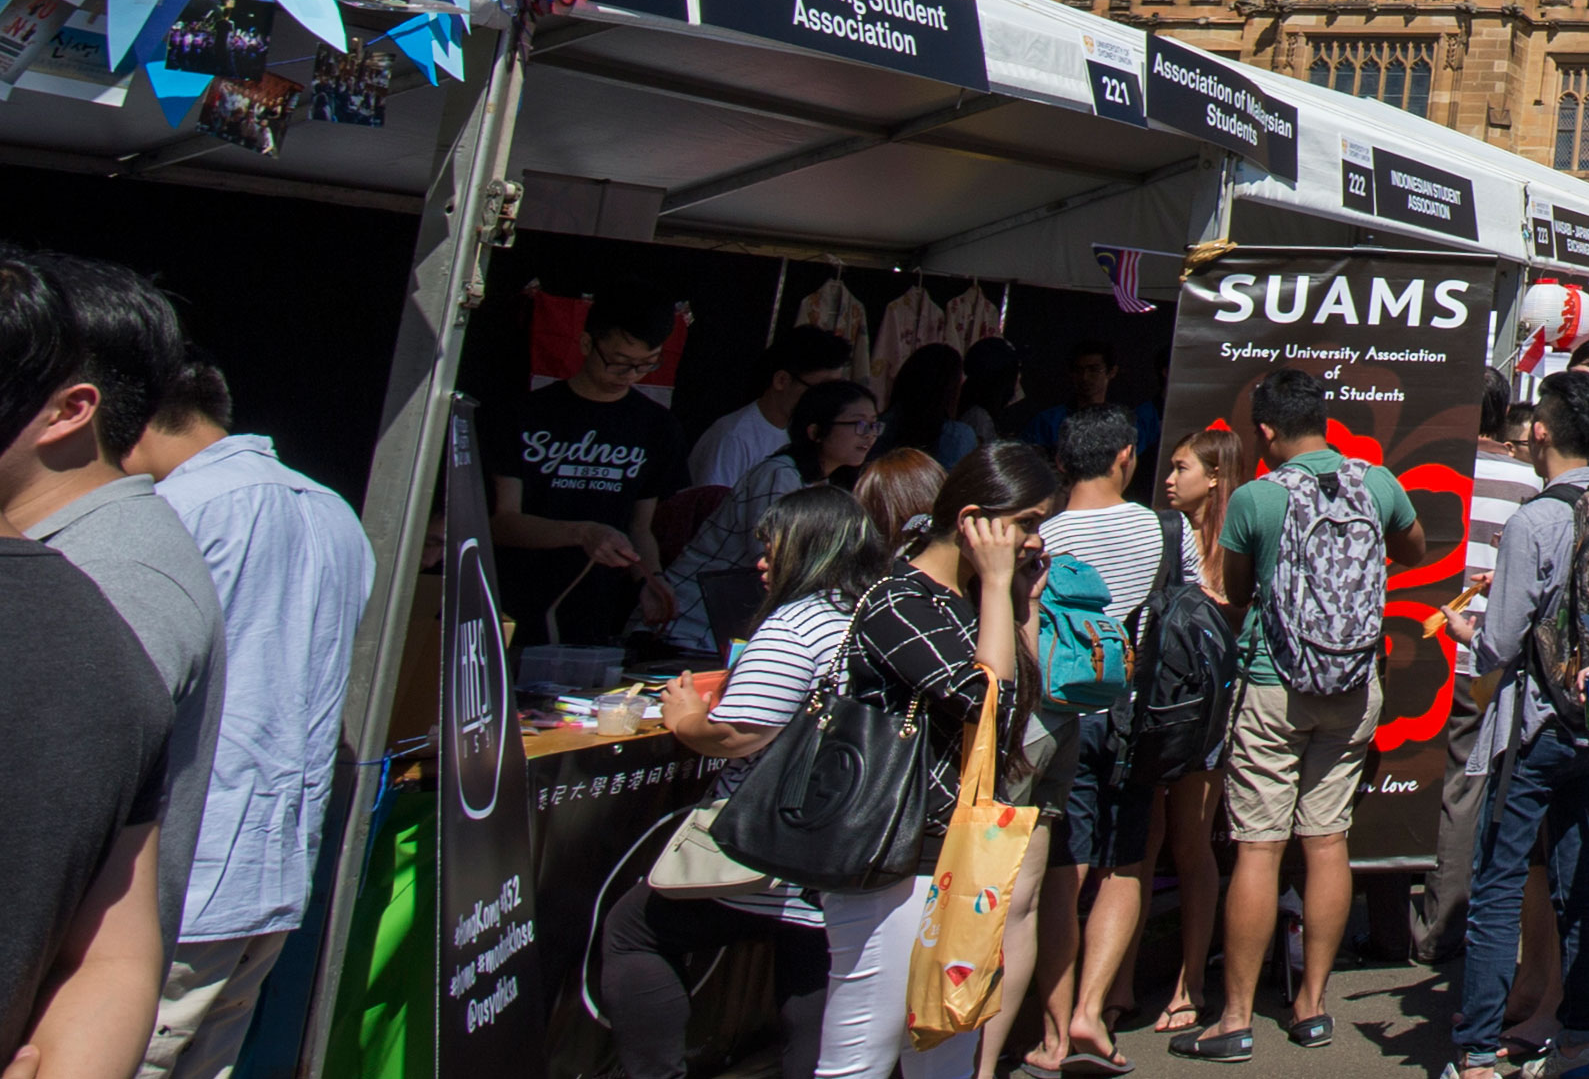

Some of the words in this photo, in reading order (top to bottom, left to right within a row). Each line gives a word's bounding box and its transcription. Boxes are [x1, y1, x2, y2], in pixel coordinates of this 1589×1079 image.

[1101, 75, 1131, 106] 221
[1153, 52, 1233, 105] Association
[1234, 89, 1247, 111] of
[1246, 93, 1293, 139] Malaysian
[1206, 103, 1258, 146] Students
[1348, 172, 1366, 197] 222
[1390, 169, 1433, 197] INDONESIAN
[1433, 182, 1461, 205] STUDENT
[1407, 194, 1451, 220] ASSOCIATION
[1537, 226, 1549, 245] 223
[1213, 273, 1470, 329] SUAMS
[1220, 342, 1280, 362] Sydney
[1285, 344, 1360, 363] University
[1365, 345, 1447, 363] Association
[1324, 364, 1342, 380] of
[1339, 385, 1405, 402] Students
[521, 429, 649, 478] Sydney
[573, 466, 610, 477] 1850
[551, 478, 587, 489] HONG
[588, 480, 624, 493] KONG
[1382, 774, 1419, 793] love
